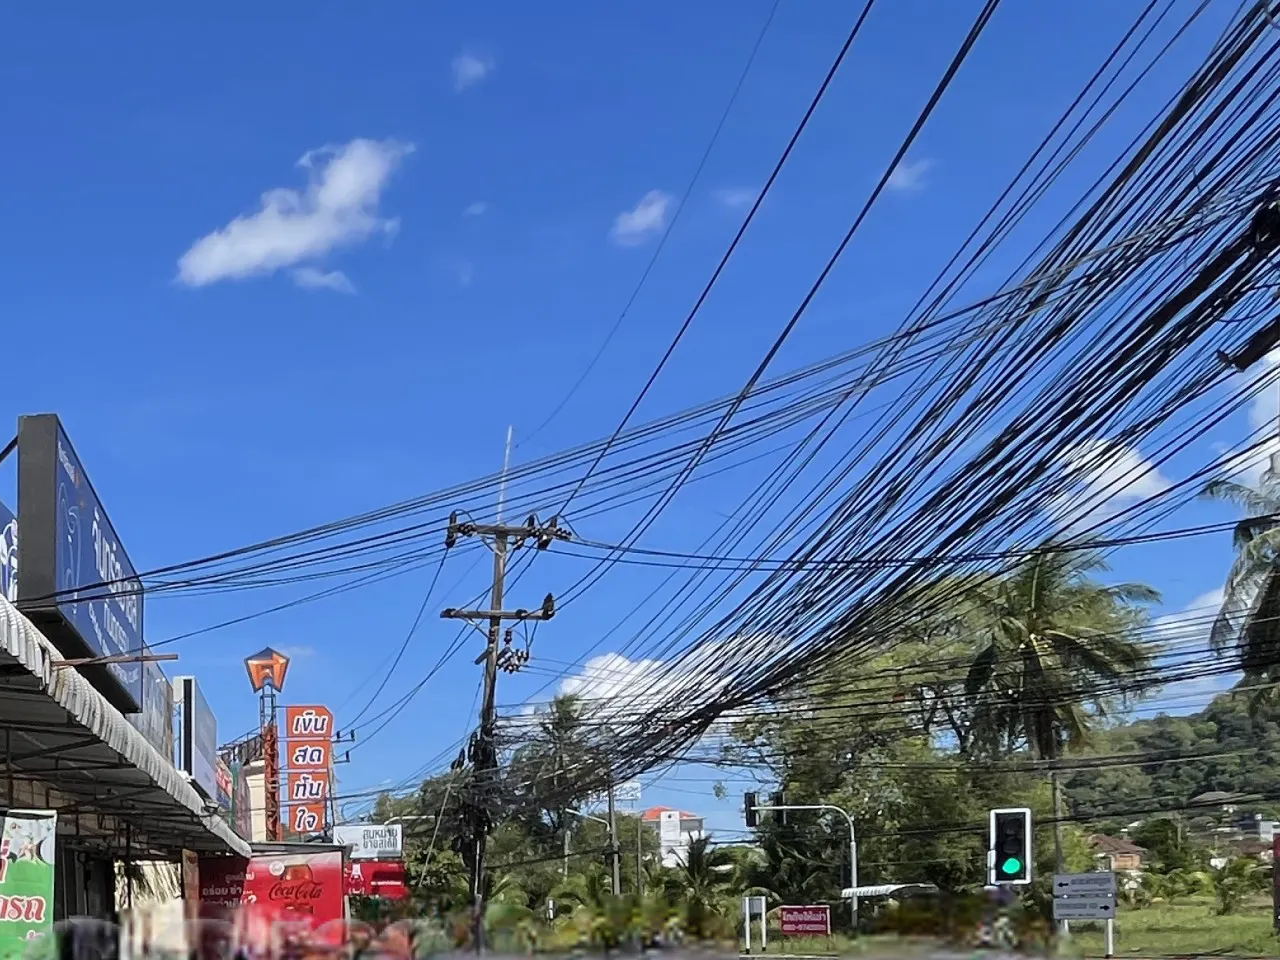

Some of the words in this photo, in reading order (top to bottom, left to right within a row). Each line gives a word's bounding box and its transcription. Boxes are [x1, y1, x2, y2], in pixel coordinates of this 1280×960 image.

[293, 710, 328, 734] เงิน
[294, 746, 323, 765] สด
[294, 775, 323, 799] ทัน
[295, 805, 319, 831] ใจ
